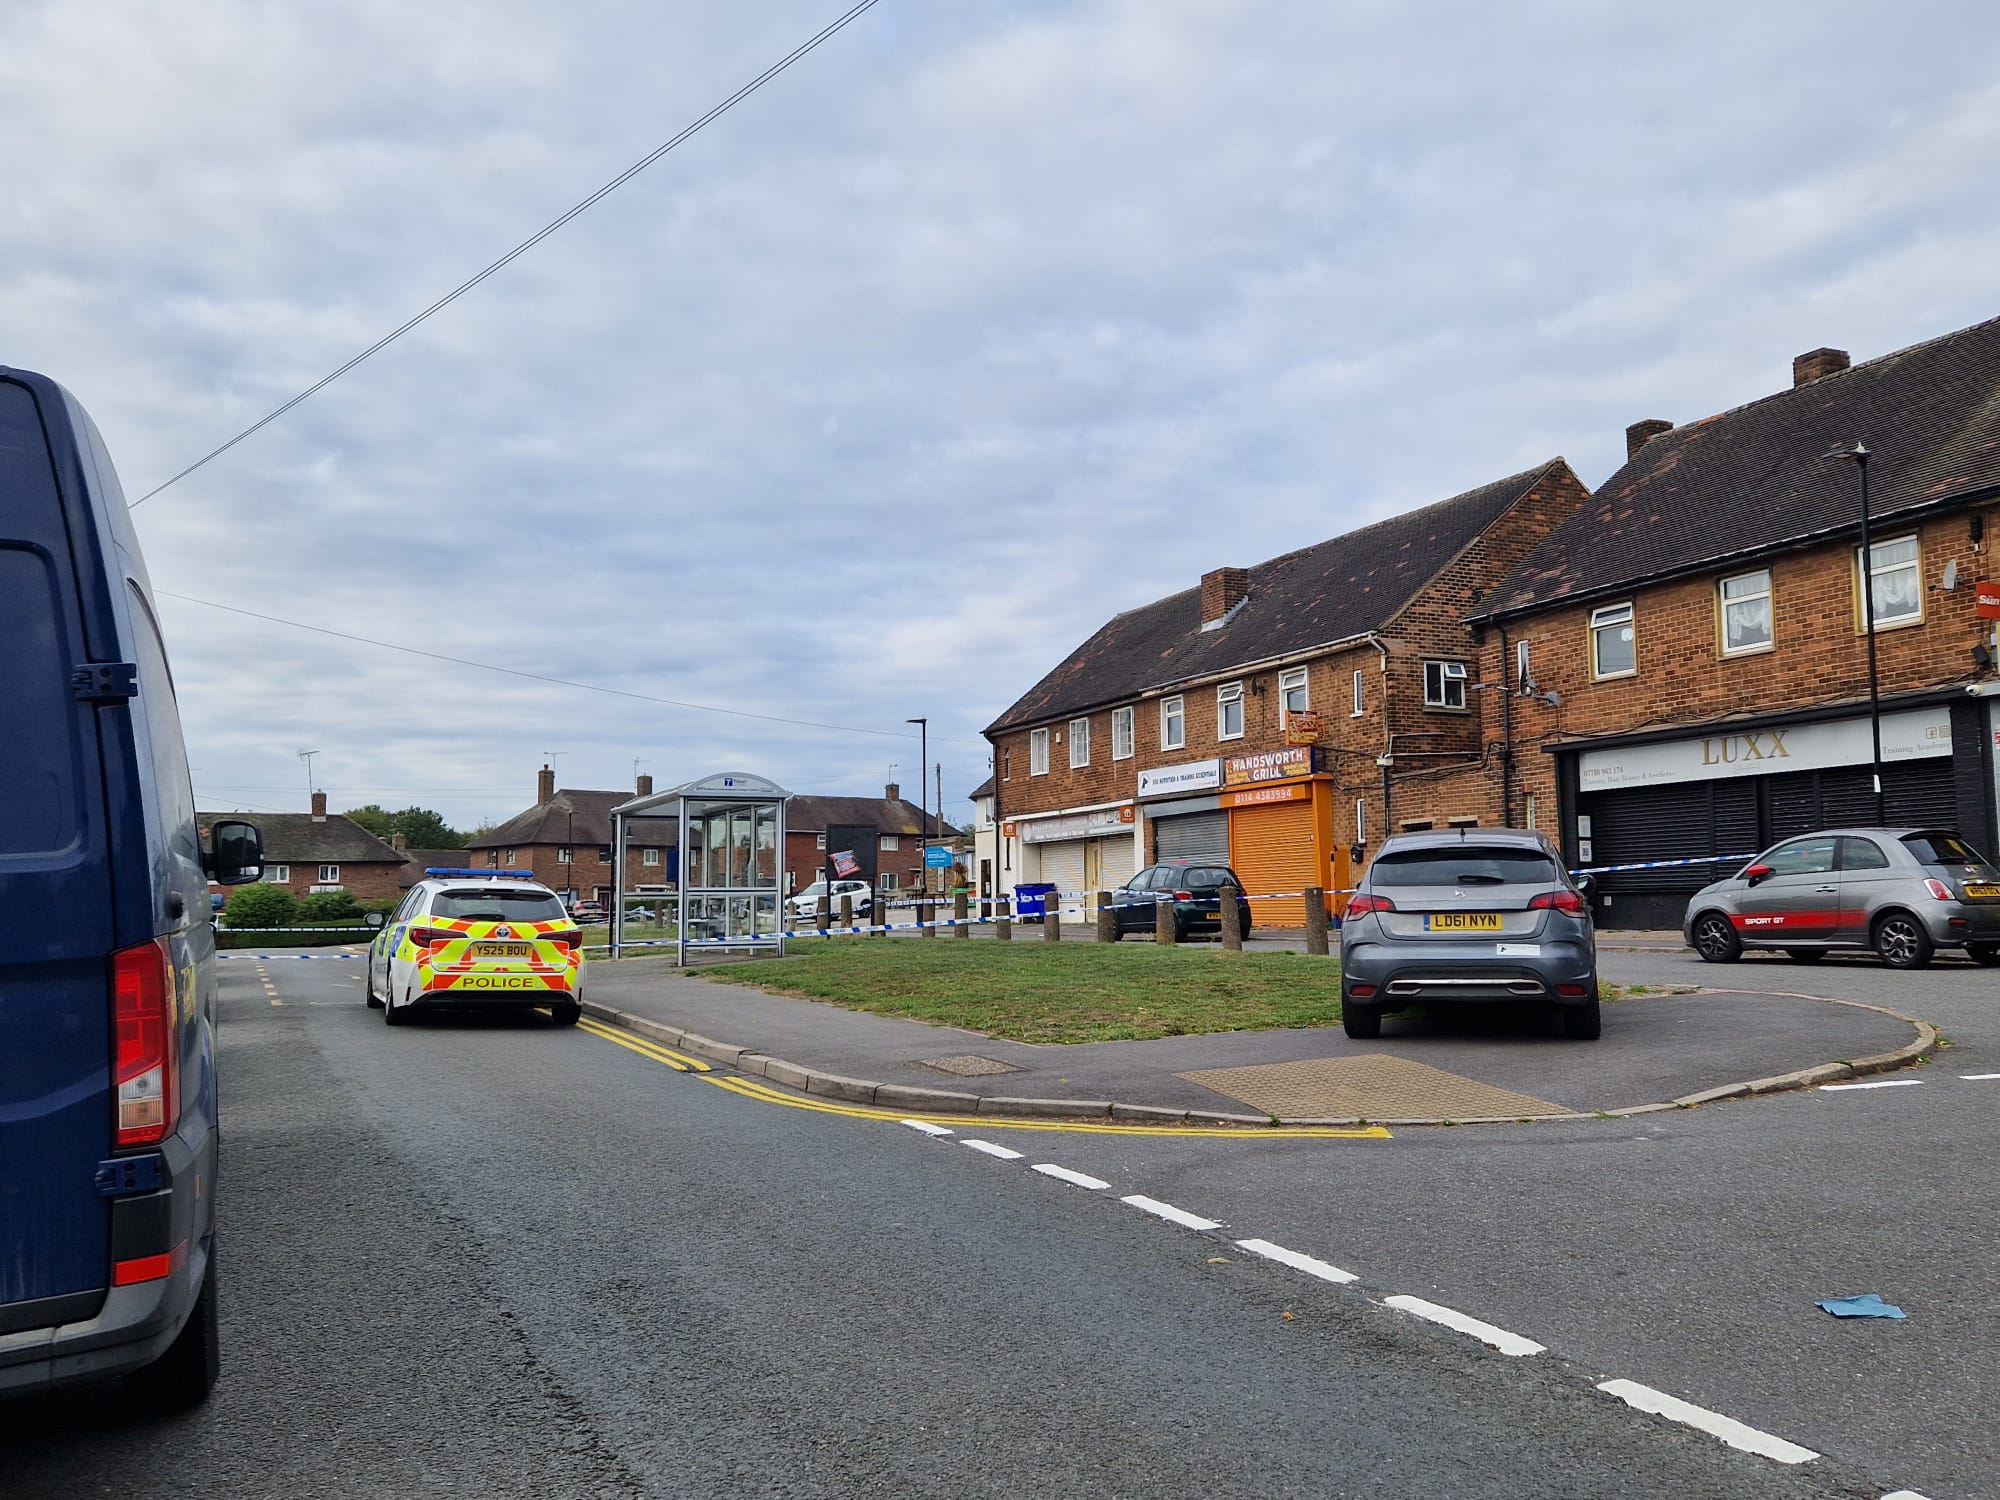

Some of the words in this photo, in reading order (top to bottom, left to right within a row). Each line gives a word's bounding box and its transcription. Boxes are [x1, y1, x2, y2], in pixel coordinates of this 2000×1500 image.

[1701, 729, 1790, 765] LUXX
[1233, 750, 1303, 772] HANDSWORTH
[1253, 766, 1281, 780] GRILL
[1235, 793, 1253, 803] 0114
[1435, 915, 1466, 927] LD61
[1469, 914, 1497, 927] NYN
[477, 945, 504, 955] YS25
[507, 945, 528, 956] BOU
[463, 977, 534, 988] POLICE
